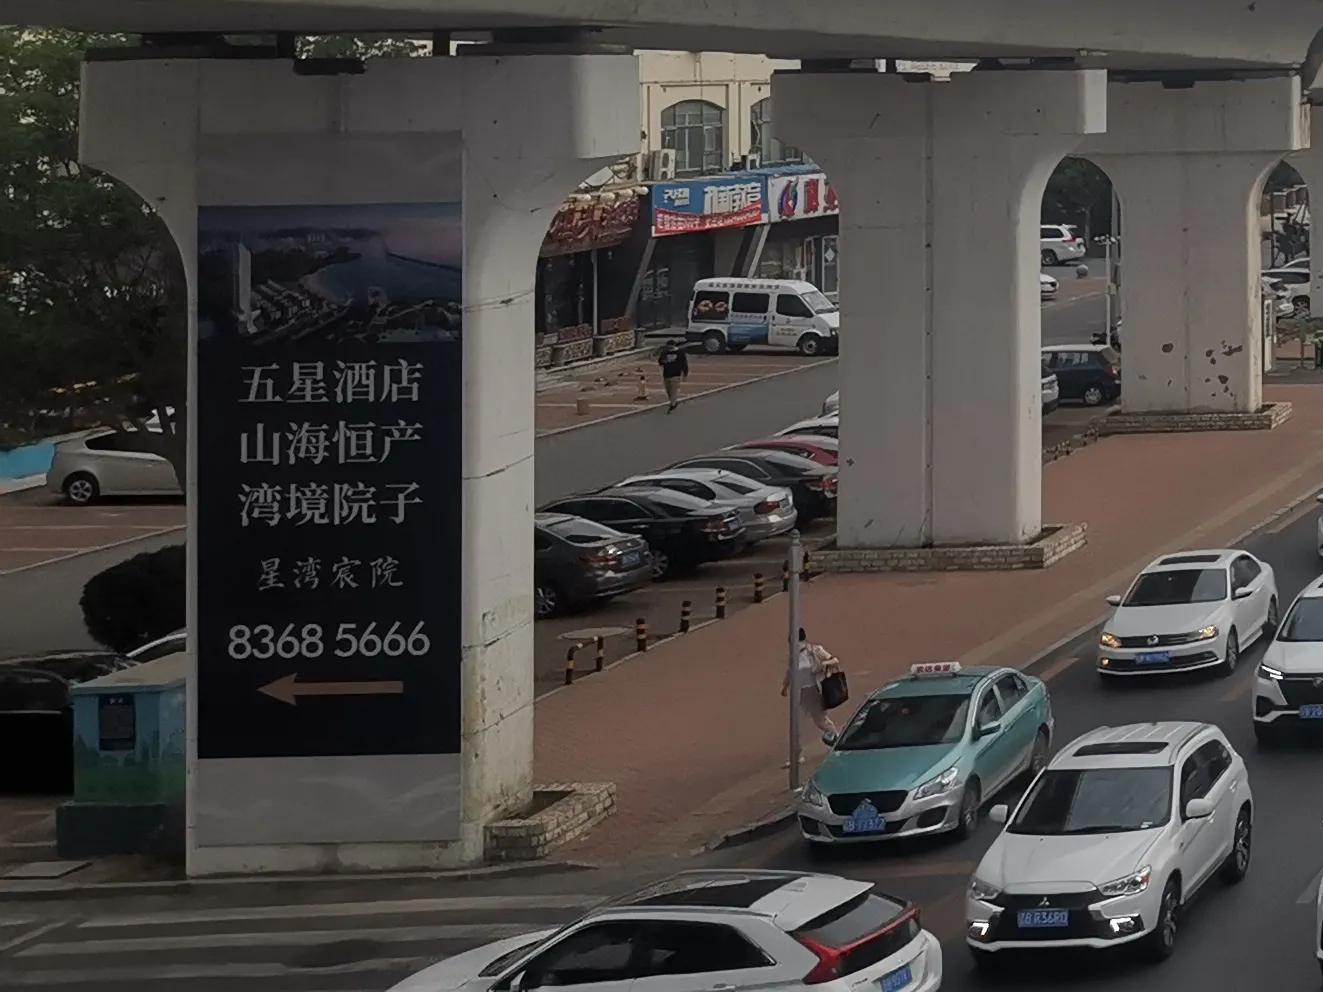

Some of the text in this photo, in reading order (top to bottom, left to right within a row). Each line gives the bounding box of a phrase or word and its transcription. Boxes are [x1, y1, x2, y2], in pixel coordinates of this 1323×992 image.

[238, 358, 425, 404] 五星酒店
[238, 418, 424, 466] 山海恒产
[237, 480, 424, 528] 湾境院子
[257, 555, 404, 591] 星湾宸院
[227, 620, 431, 660] 8368 5666
